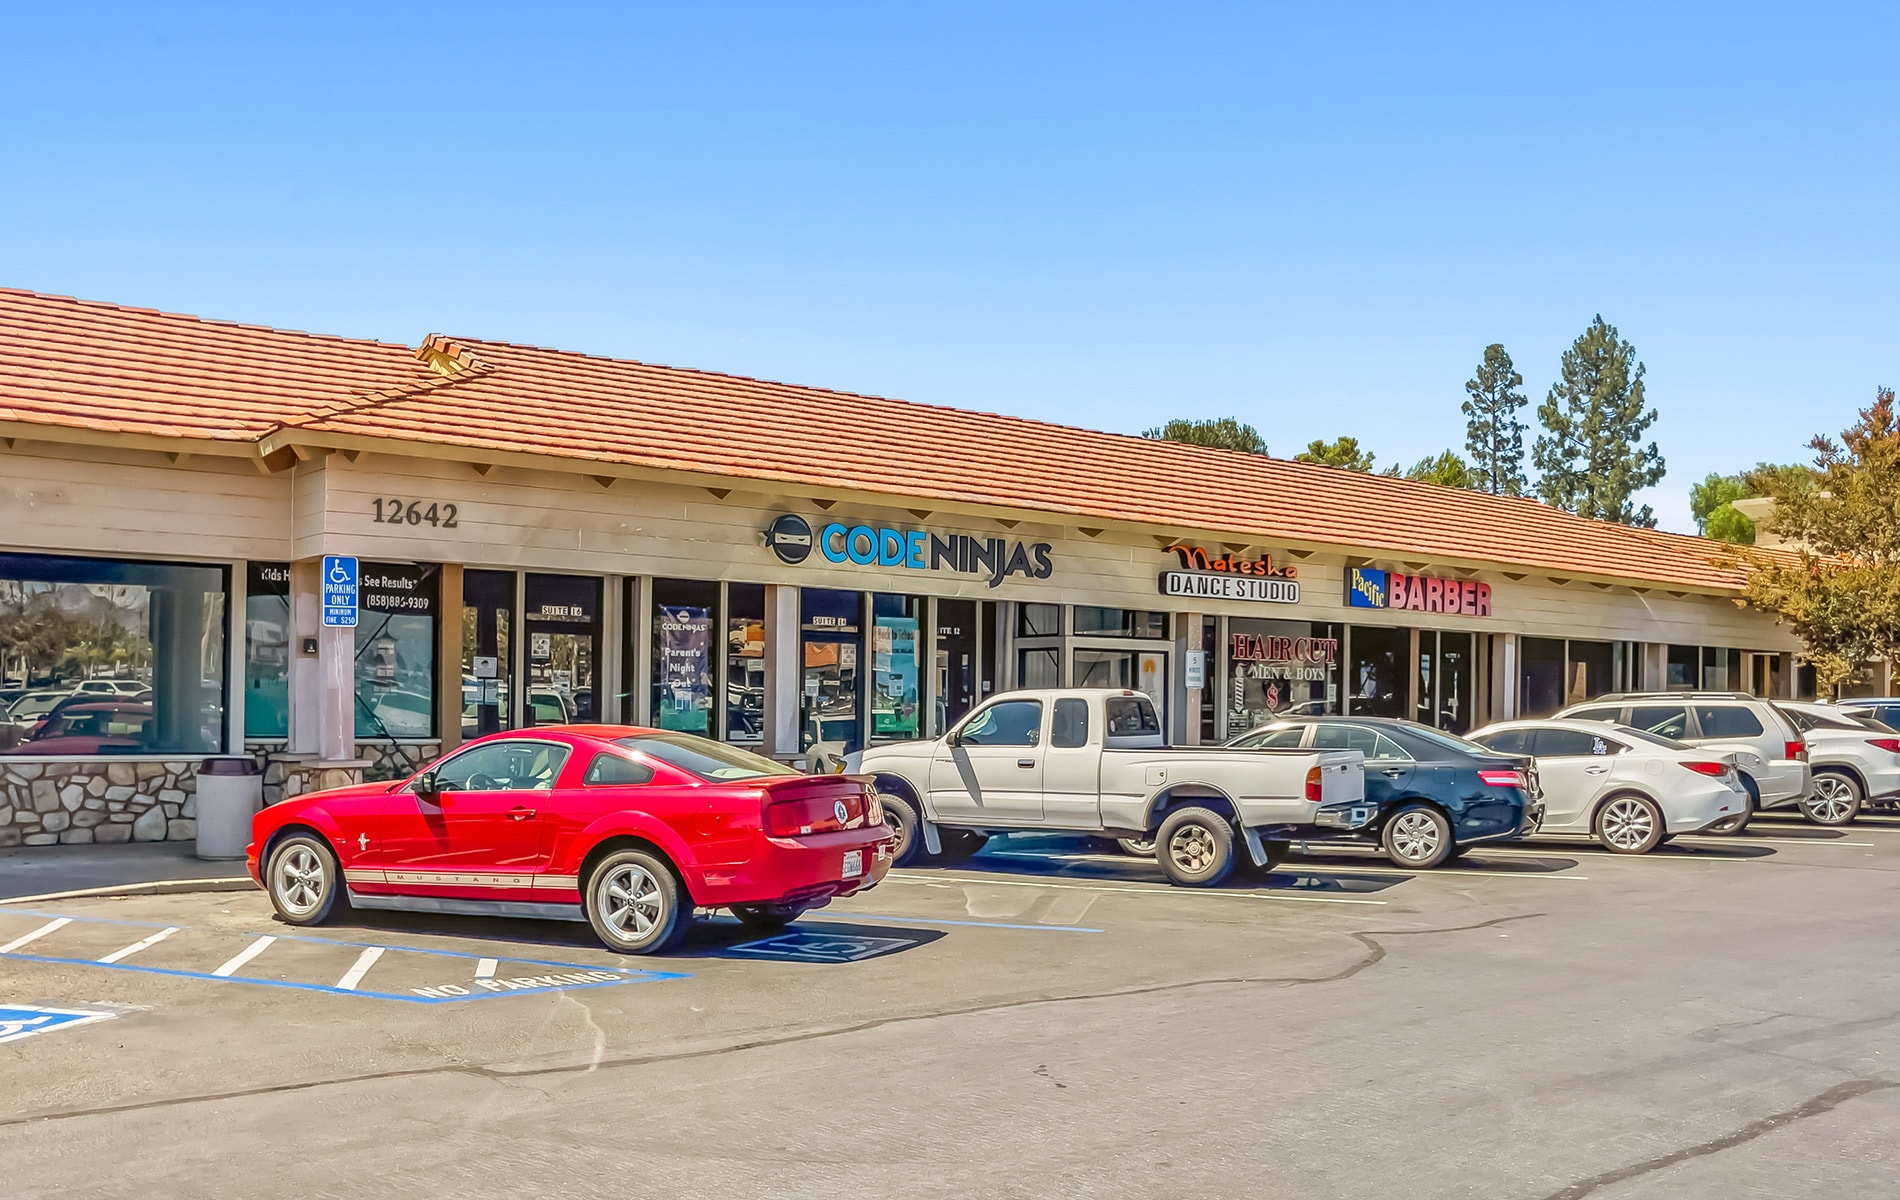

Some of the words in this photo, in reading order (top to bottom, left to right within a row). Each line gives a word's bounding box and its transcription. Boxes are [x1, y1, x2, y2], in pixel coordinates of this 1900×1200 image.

[372, 498, 458, 528] 12642
[821, 522, 926, 569] CODE
[930, 532, 1053, 588] NINJAS
[325, 583, 356, 594] PARKING
[364, 575, 380, 588] See
[1170, 575, 1231, 597] DANCE
[1236, 580, 1297, 601] STUDIO
[1351, 568, 1385, 608] Pacific
[1389, 572, 1492, 617] BARBER
[331, 595, 350, 605] ONLY
[542, 606, 569, 615] SUITE
[325, 616, 338, 624] FINE
[813, 616, 836, 626] SUITE
[1232, 633, 1338, 664] HAIRCUT
[669, 662, 696, 676] Night
[1251, 665, 1280, 680] MEN
[1296, 667, 1326, 681] BOYS
[396, 874, 521, 884] MUSTANG
[410, 984, 471, 999] NO
[474, 970, 622, 993] PARKING
